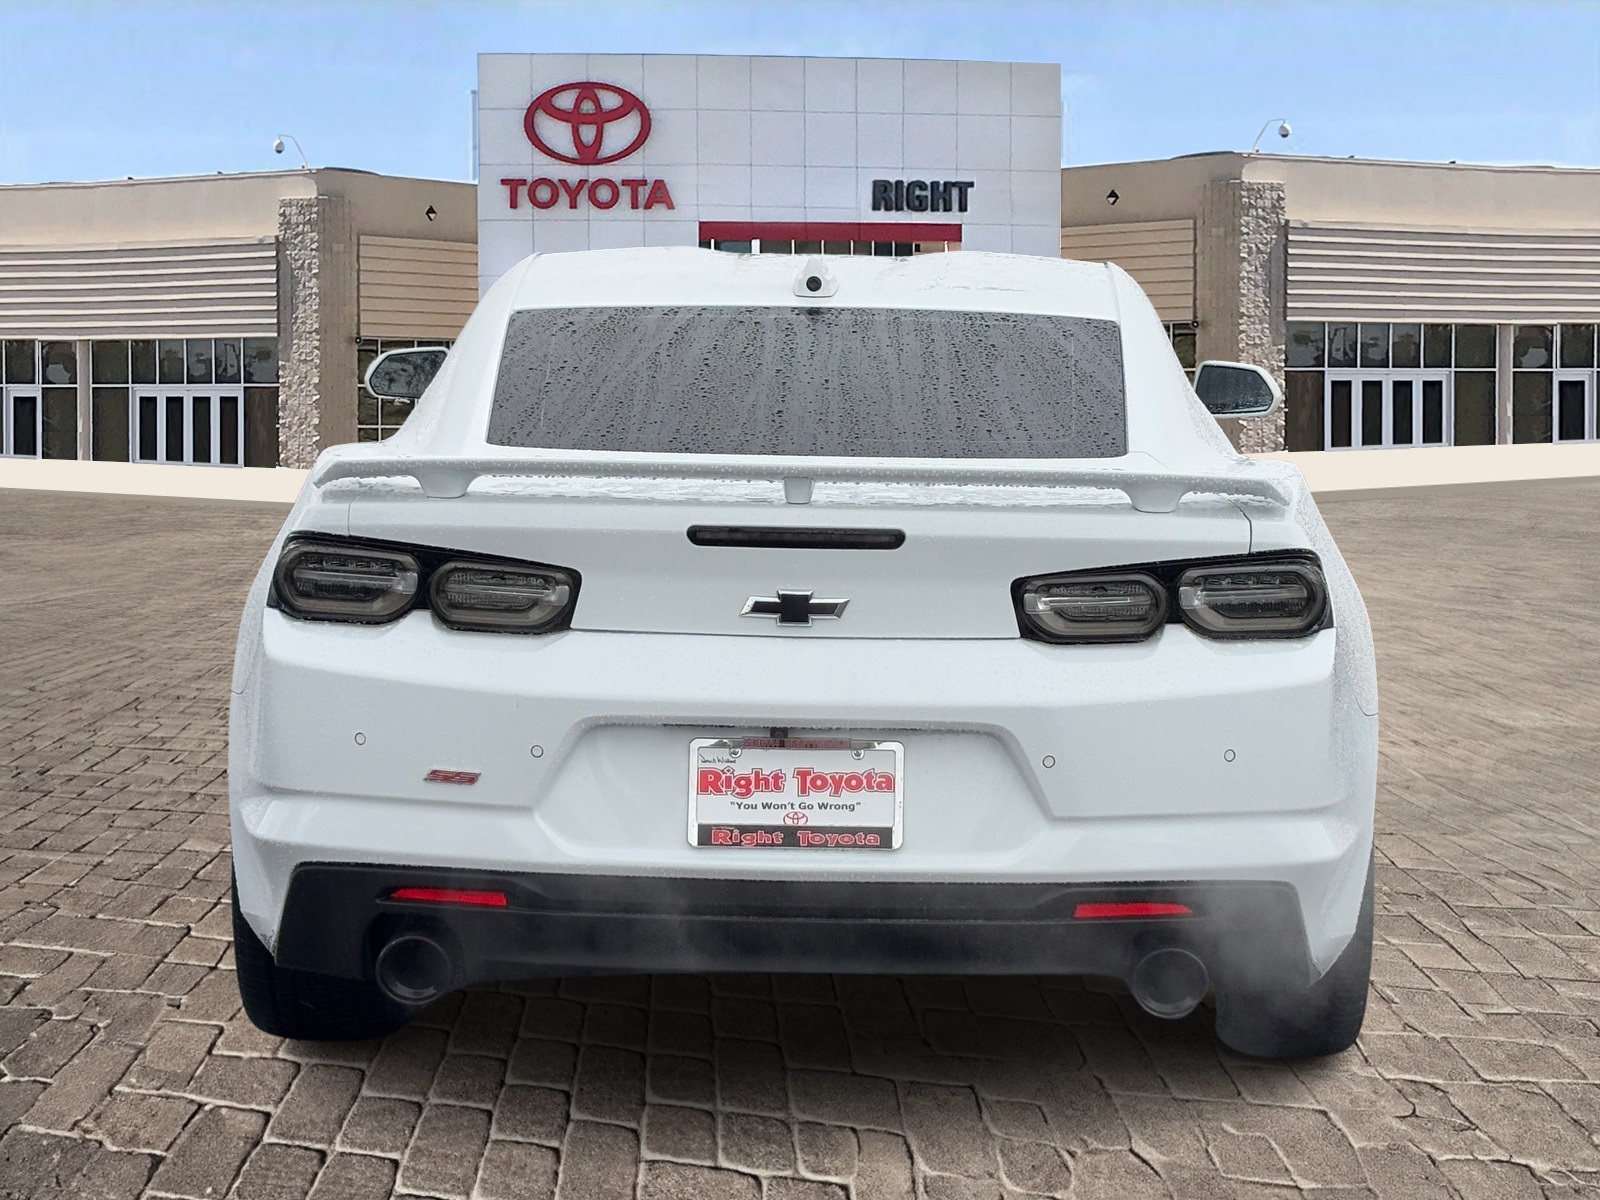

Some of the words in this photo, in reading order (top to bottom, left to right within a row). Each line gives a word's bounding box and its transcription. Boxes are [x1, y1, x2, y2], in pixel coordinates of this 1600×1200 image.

[500, 178, 675, 209] TOYOTA
[871, 179, 975, 212] RIGHT
[698, 766, 786, 798] Right
[793, 767, 895, 797] Toyota
[730, 801, 758, 811] "You
[761, 802, 796, 811] Won't
[798, 803, 814, 811] Go
[817, 802, 861, 812] Wrong"
[711, 829, 784, 846] Right
[796, 830, 880, 846] Toyota
